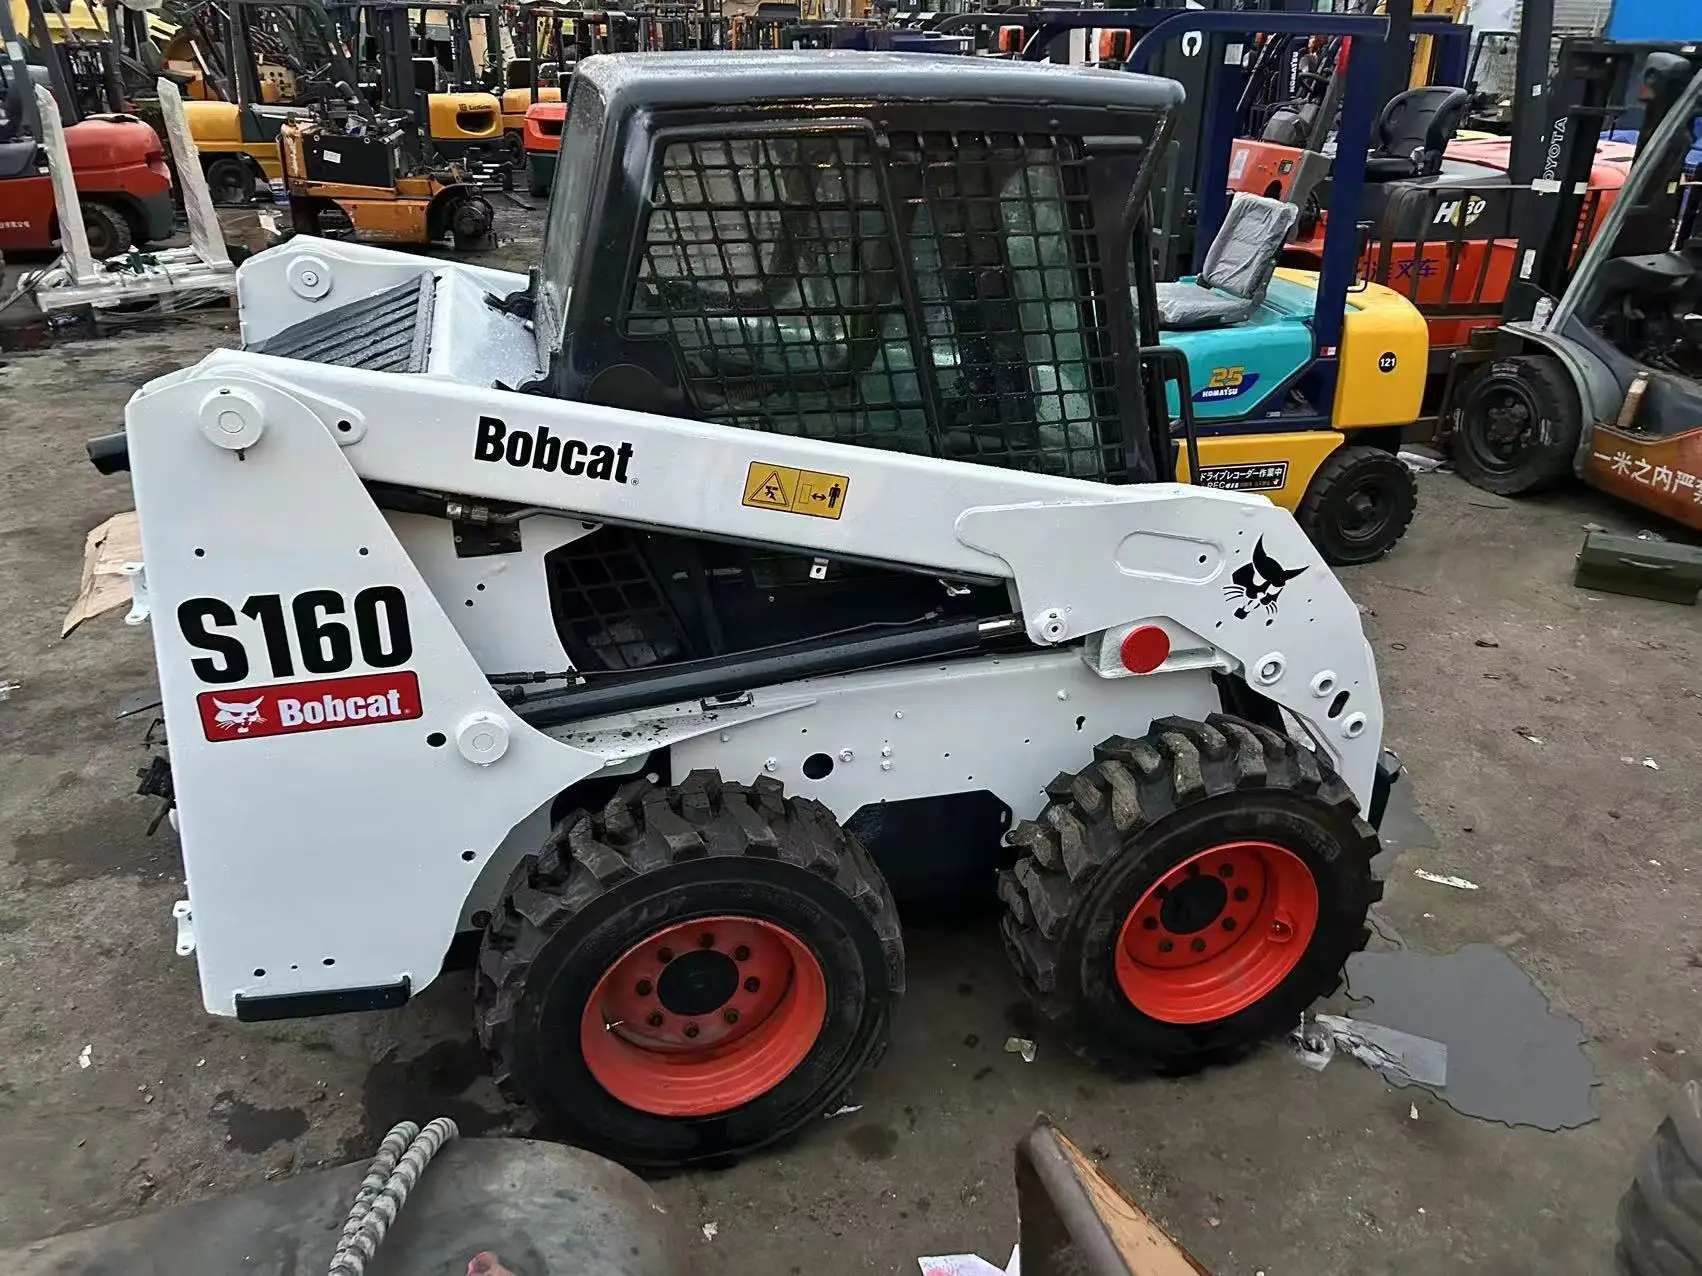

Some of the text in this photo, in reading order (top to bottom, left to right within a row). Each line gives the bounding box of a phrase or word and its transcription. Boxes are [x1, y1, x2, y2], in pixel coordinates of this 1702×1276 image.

[1541, 116, 1568, 182] OYOTA
[1208, 365, 1245, 388] 25
[1380, 357, 1396, 367] 121
[1202, 387, 1239, 398] KOMATSU
[475, 415, 633, 484] Bobcat
[177, 585, 413, 684] S160
[277, 688, 401, 727] Bobcat
